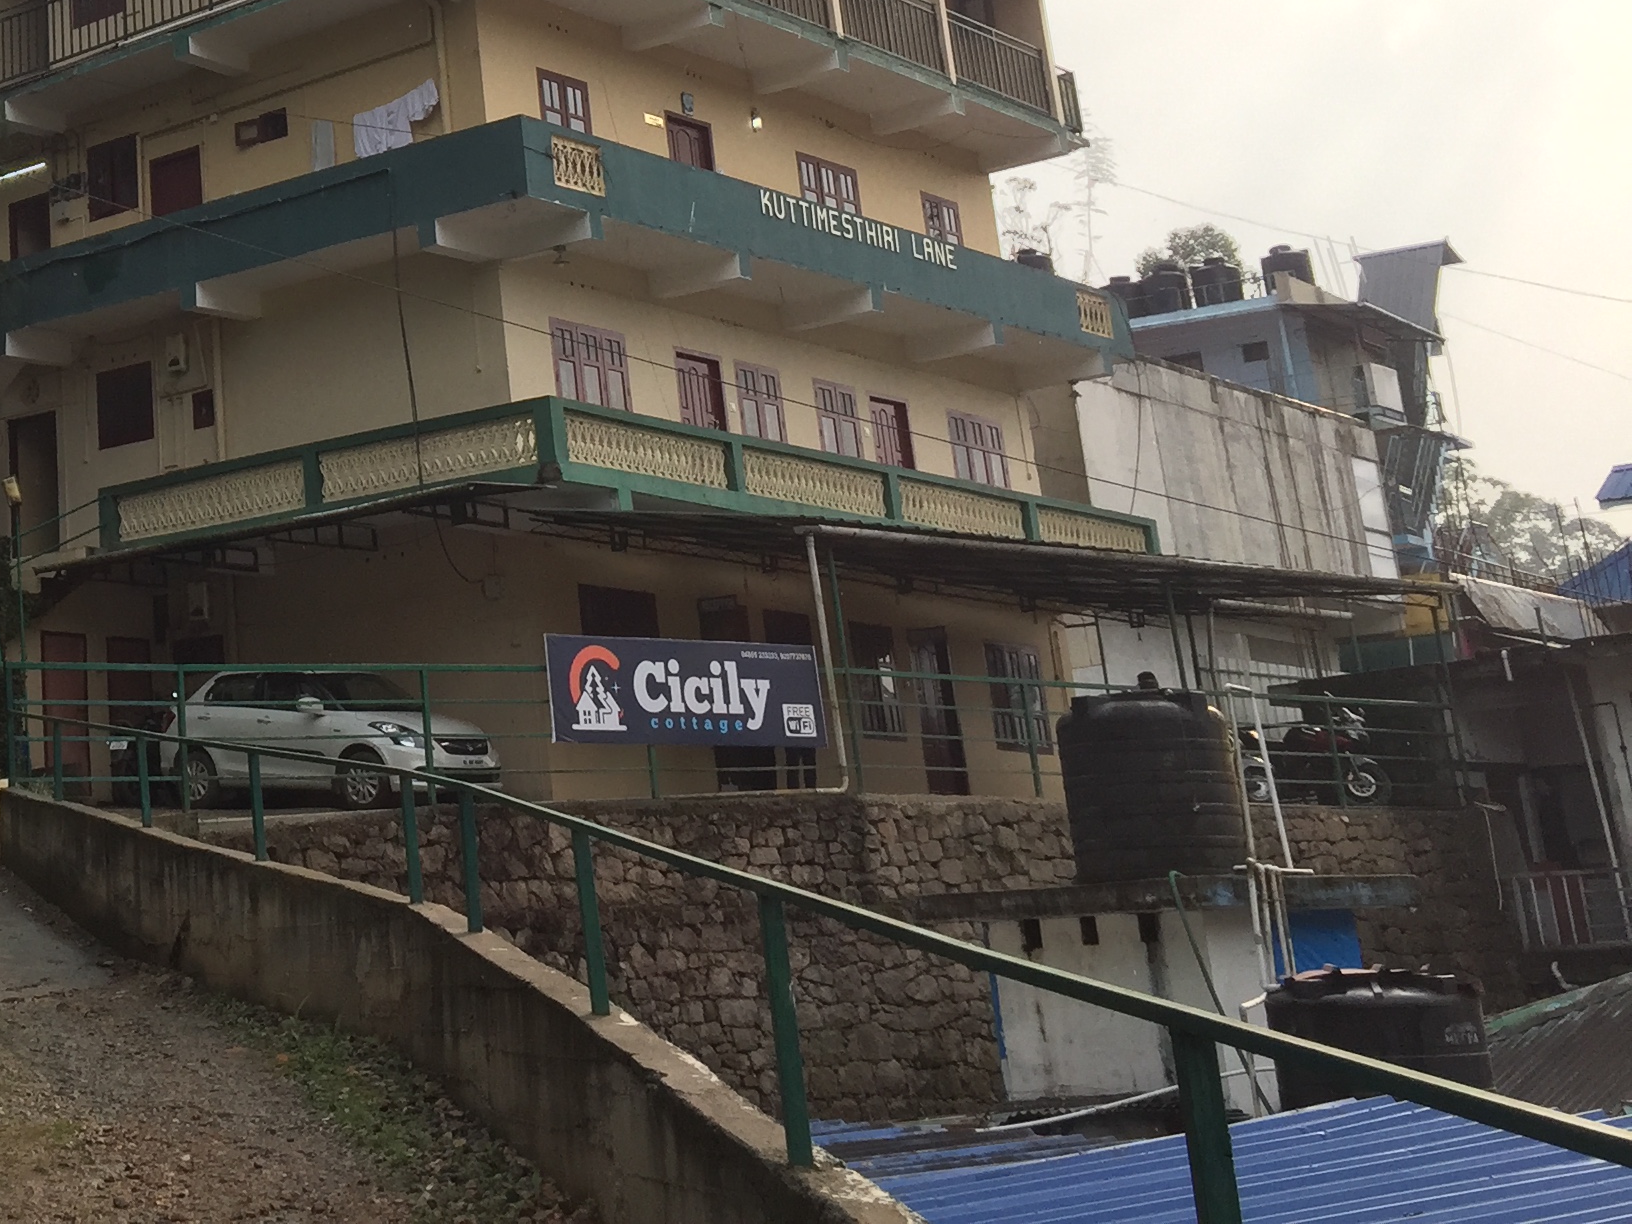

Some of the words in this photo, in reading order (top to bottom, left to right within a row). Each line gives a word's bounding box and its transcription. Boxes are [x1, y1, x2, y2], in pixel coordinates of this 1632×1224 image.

[759, 188, 901, 254] KUTTIMESTHIRI
[910, 233, 958, 270] LANE
[632, 658, 771, 731] Cicily
[786, 706, 810, 717] FREE
[650, 716, 743, 734] cottage
